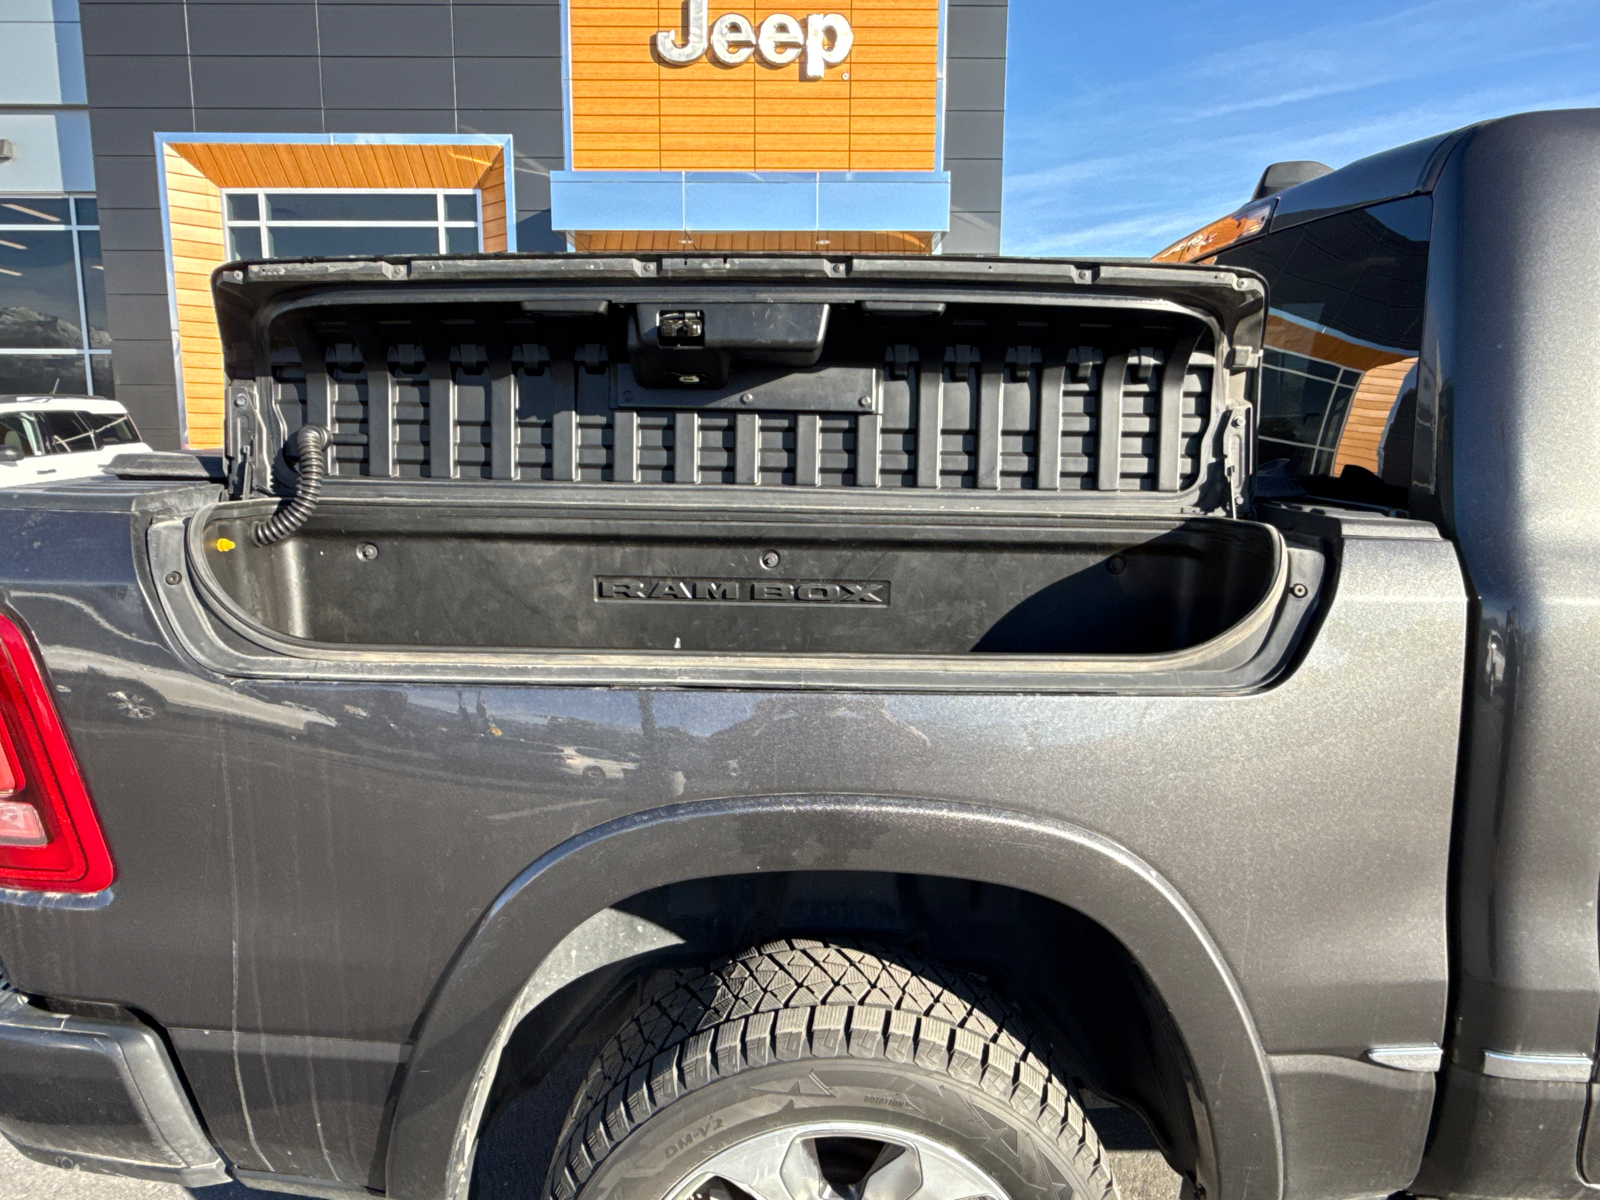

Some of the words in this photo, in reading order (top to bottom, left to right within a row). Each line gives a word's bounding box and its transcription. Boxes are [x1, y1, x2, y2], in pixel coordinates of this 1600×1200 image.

[656, 0, 853, 78] Jeep
[598, 580, 740, 600] RAM
[750, 582, 883, 602] BOX
[863, 1095, 904, 1108] ROTATION
[664, 1118, 724, 1159] DM-V2
